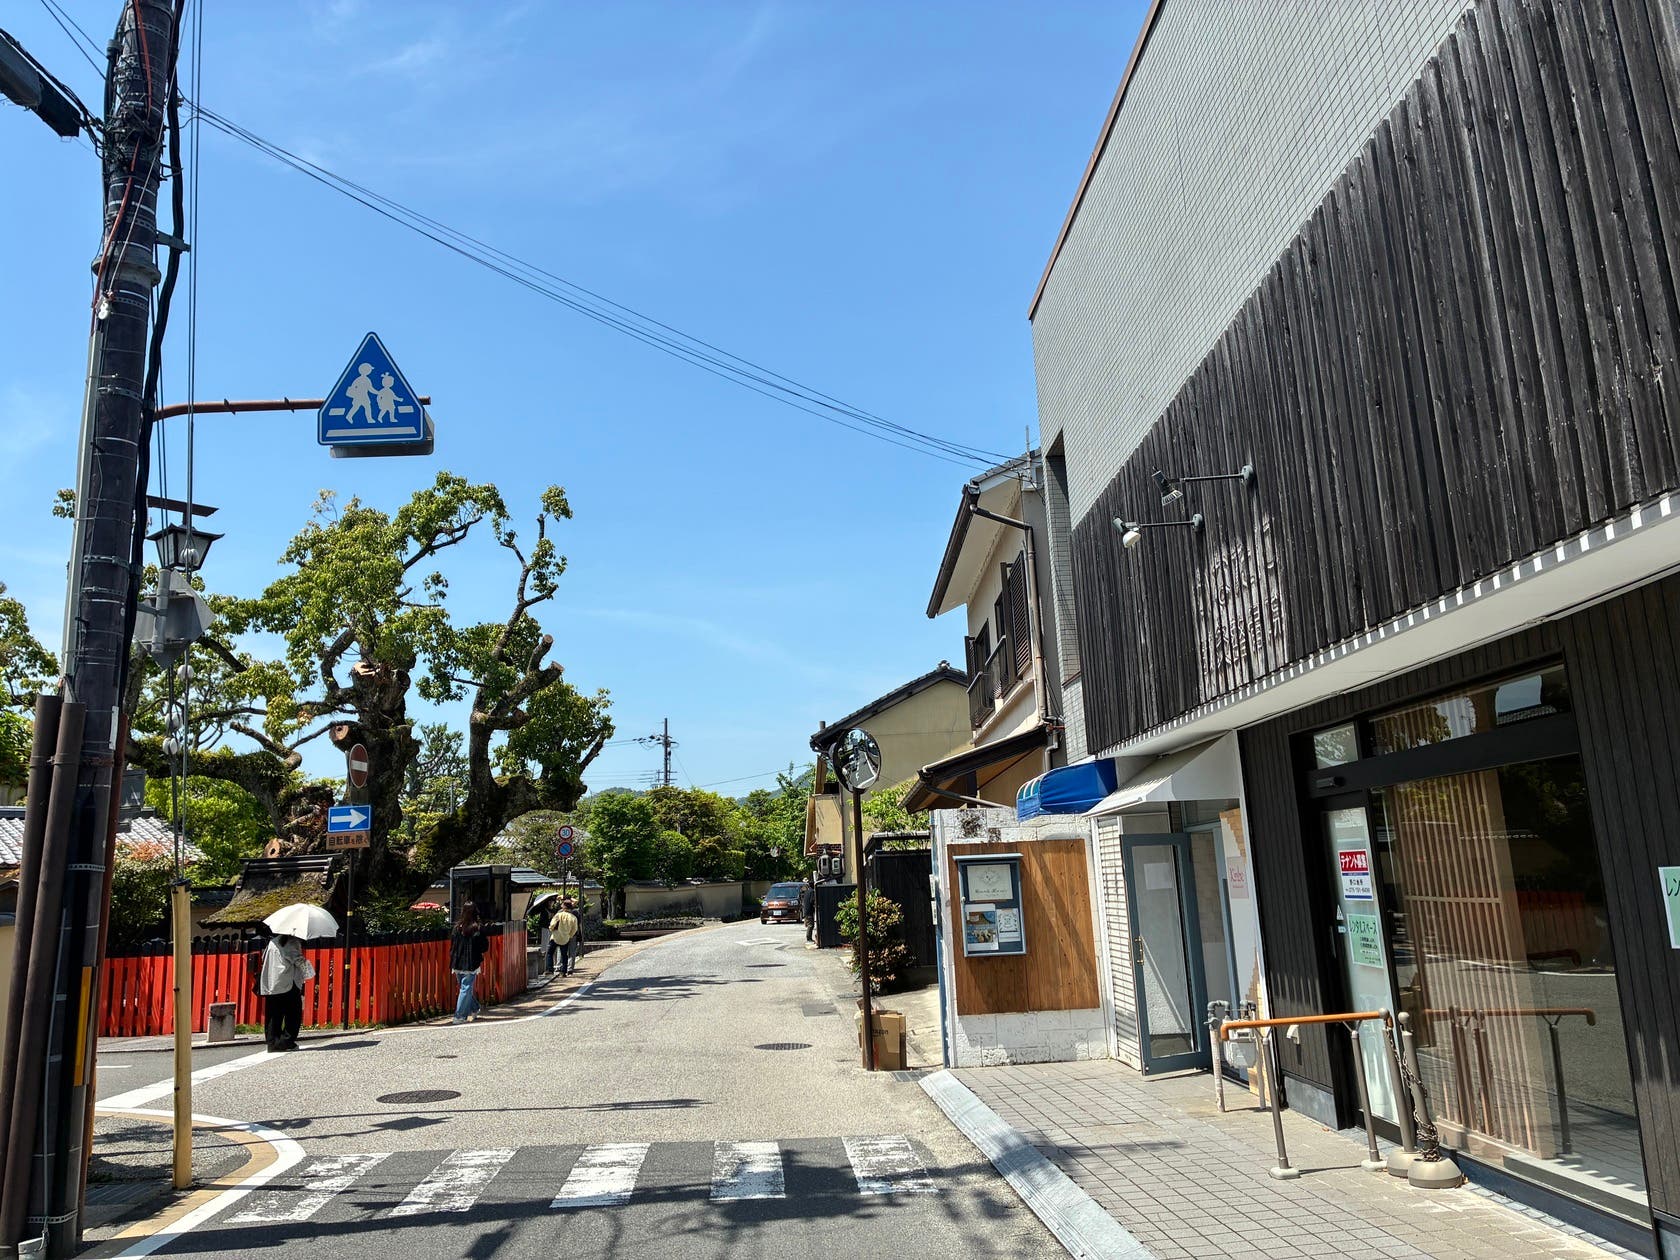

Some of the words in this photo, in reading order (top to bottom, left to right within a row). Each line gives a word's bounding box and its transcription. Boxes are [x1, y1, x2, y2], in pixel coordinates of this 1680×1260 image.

[562, 829, 570, 837] 30
[328, 835, 368, 846] 自転車を除く
[1340, 854, 1367, 868] テナント募集
